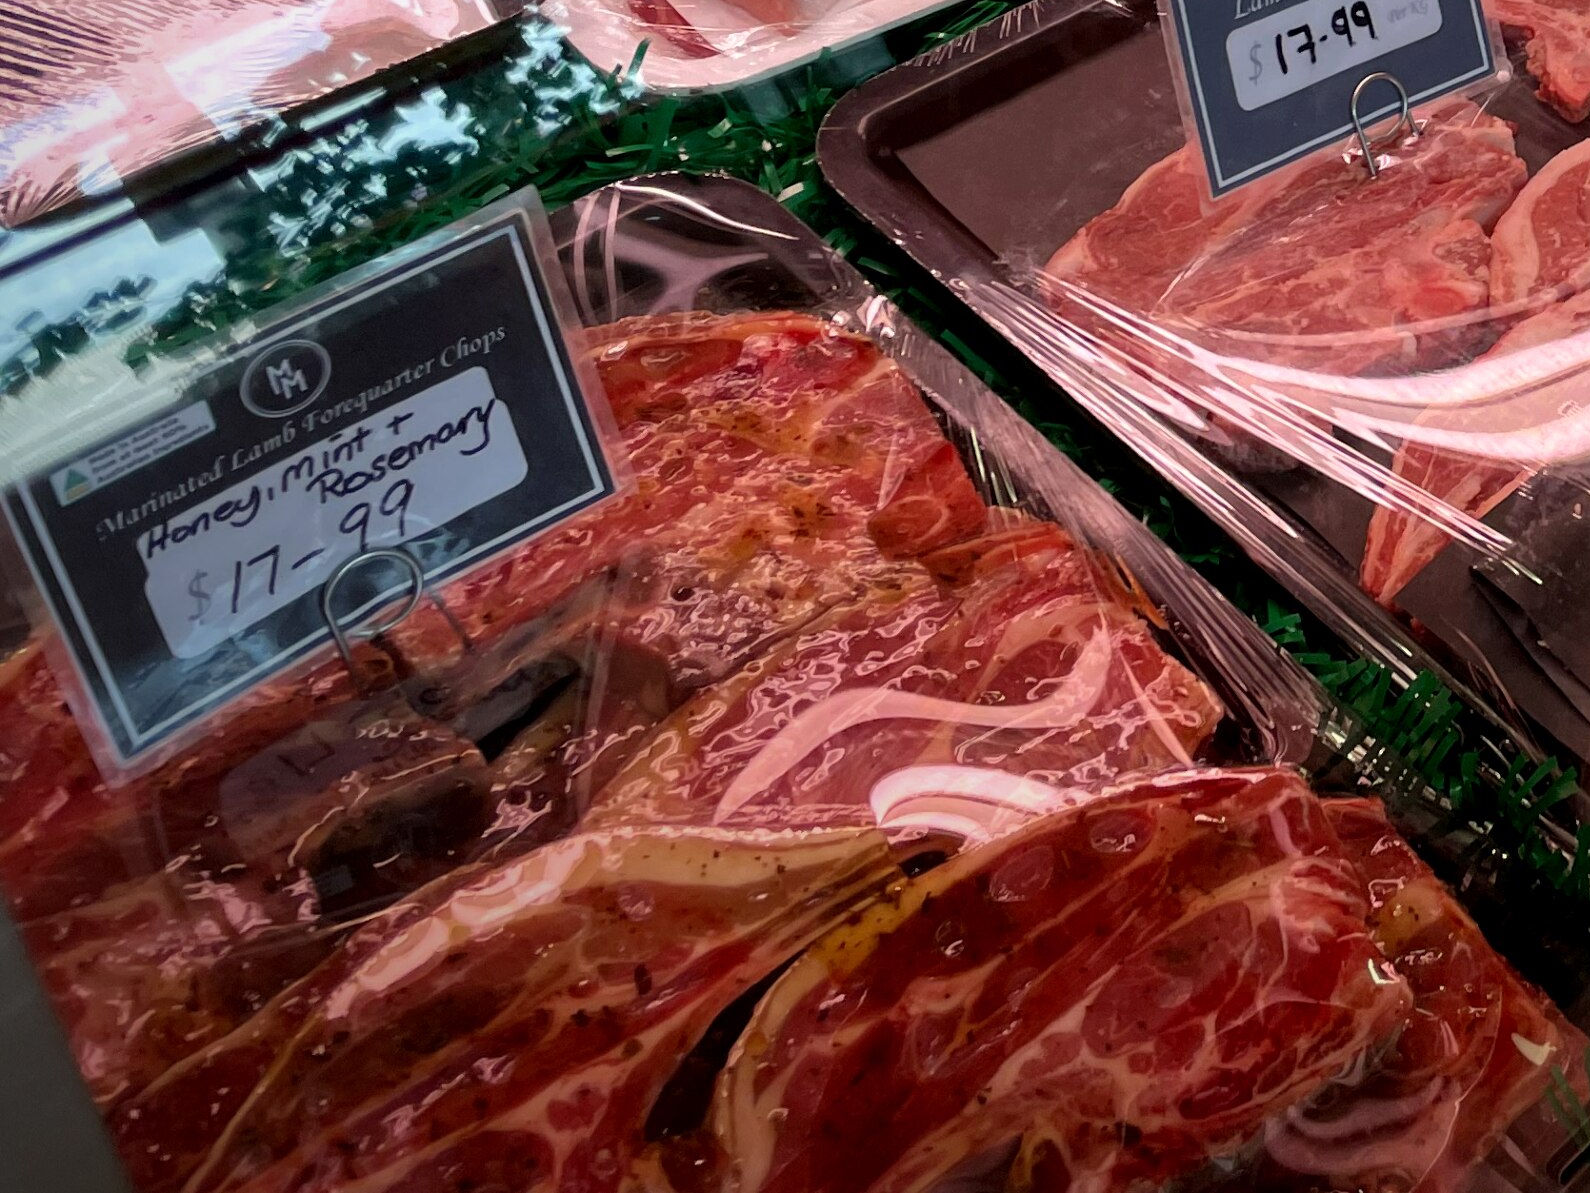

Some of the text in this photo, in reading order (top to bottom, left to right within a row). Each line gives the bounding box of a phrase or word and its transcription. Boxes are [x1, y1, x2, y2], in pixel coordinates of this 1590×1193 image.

[96, 324, 507, 541] Marinated Lamb Forequarter Chops
[306, 398, 497, 505] Rosemary
